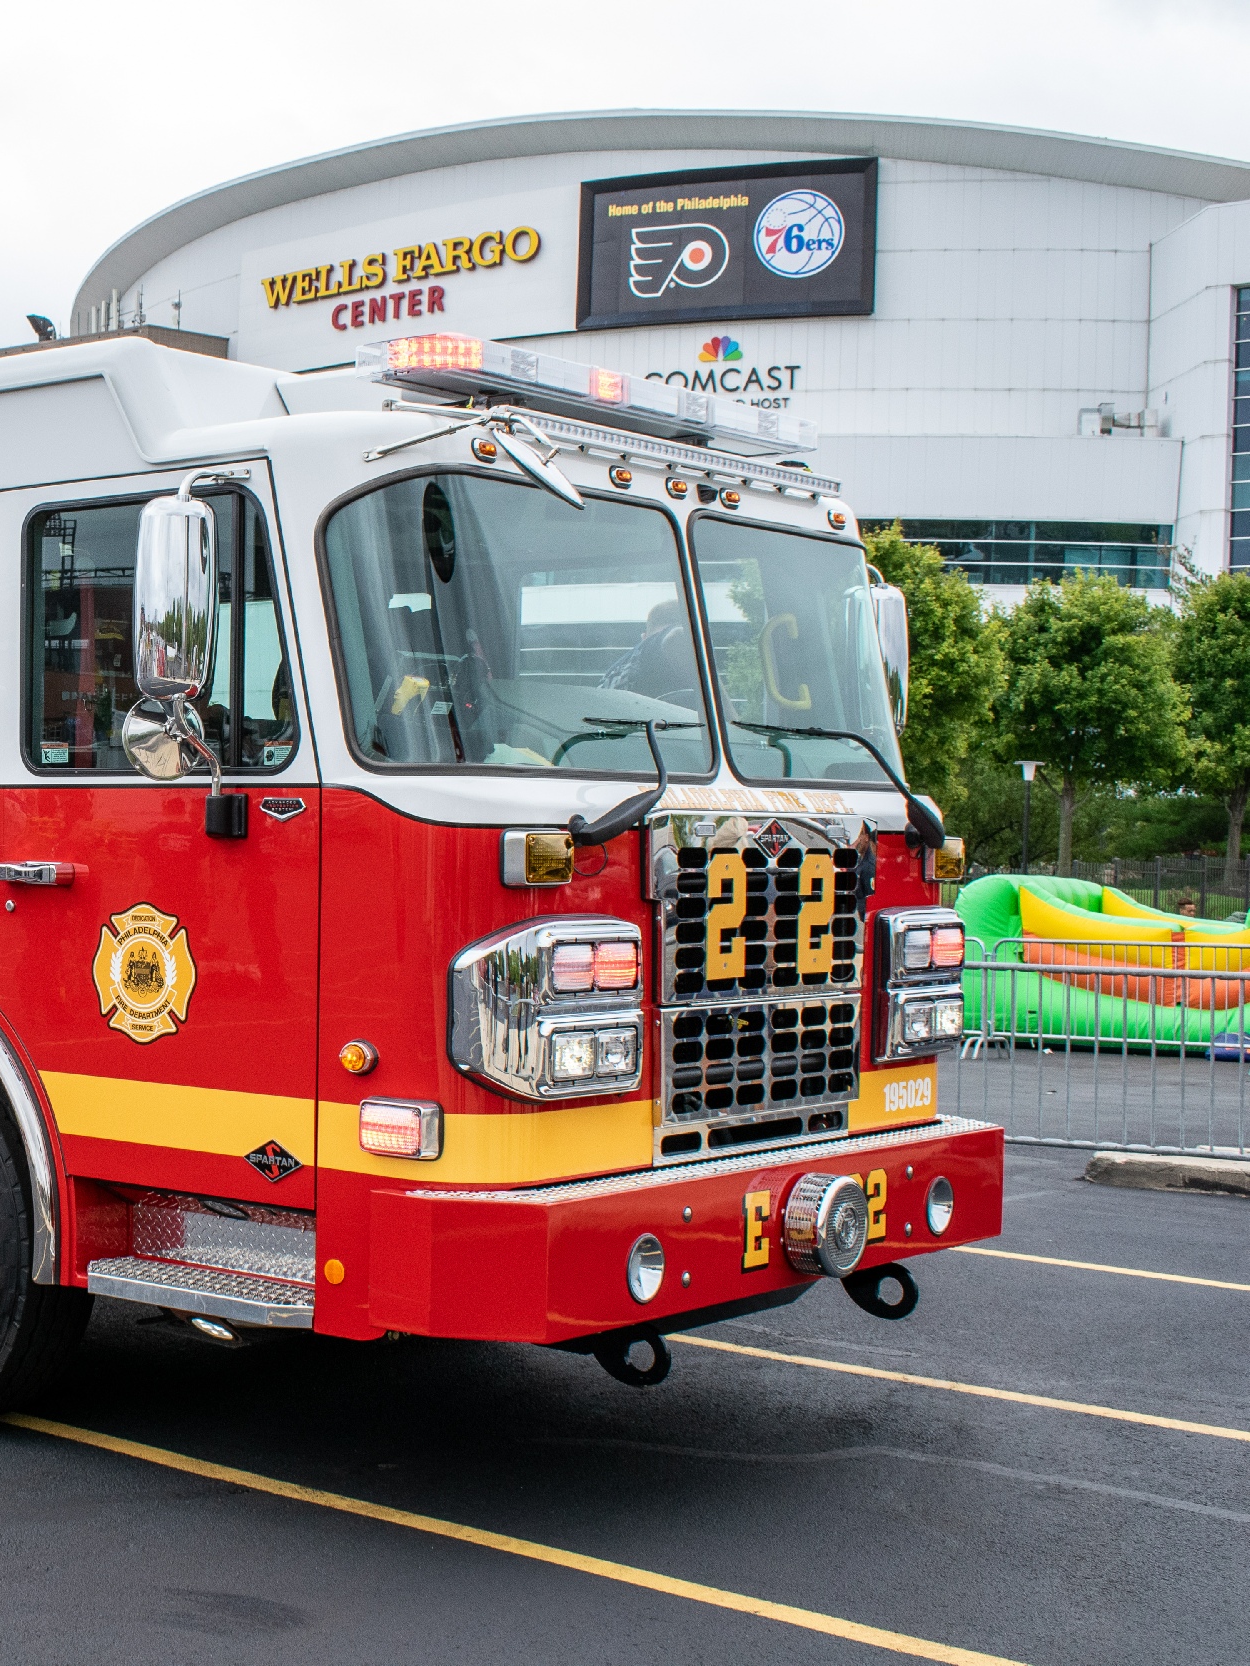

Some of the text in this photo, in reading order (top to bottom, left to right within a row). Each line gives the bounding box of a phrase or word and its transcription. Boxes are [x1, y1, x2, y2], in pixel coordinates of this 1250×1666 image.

[608, 193, 749, 217] Home of the Philadelphia
[765, 223, 835, 255] 76ers
[261, 225, 540, 309] WELLS FARGO
[331, 285, 446, 331] CENTER
[750, 397, 791, 409] HOST
[761, 790, 810, 813] FIRE
[803, 792, 855, 814] DEPT.
[760, 834, 789, 843] SPARTAN
[117, 926, 169, 947] PHILADELPHIA
[115, 994, 172, 1020] FIRE DEPARTMENT
[131, 1023, 154, 1032] SERVICE
[883, 1076, 932, 1112] 195029
[249, 1153, 295, 1168] SPARTAN
[741, 1189, 771, 1274] E
